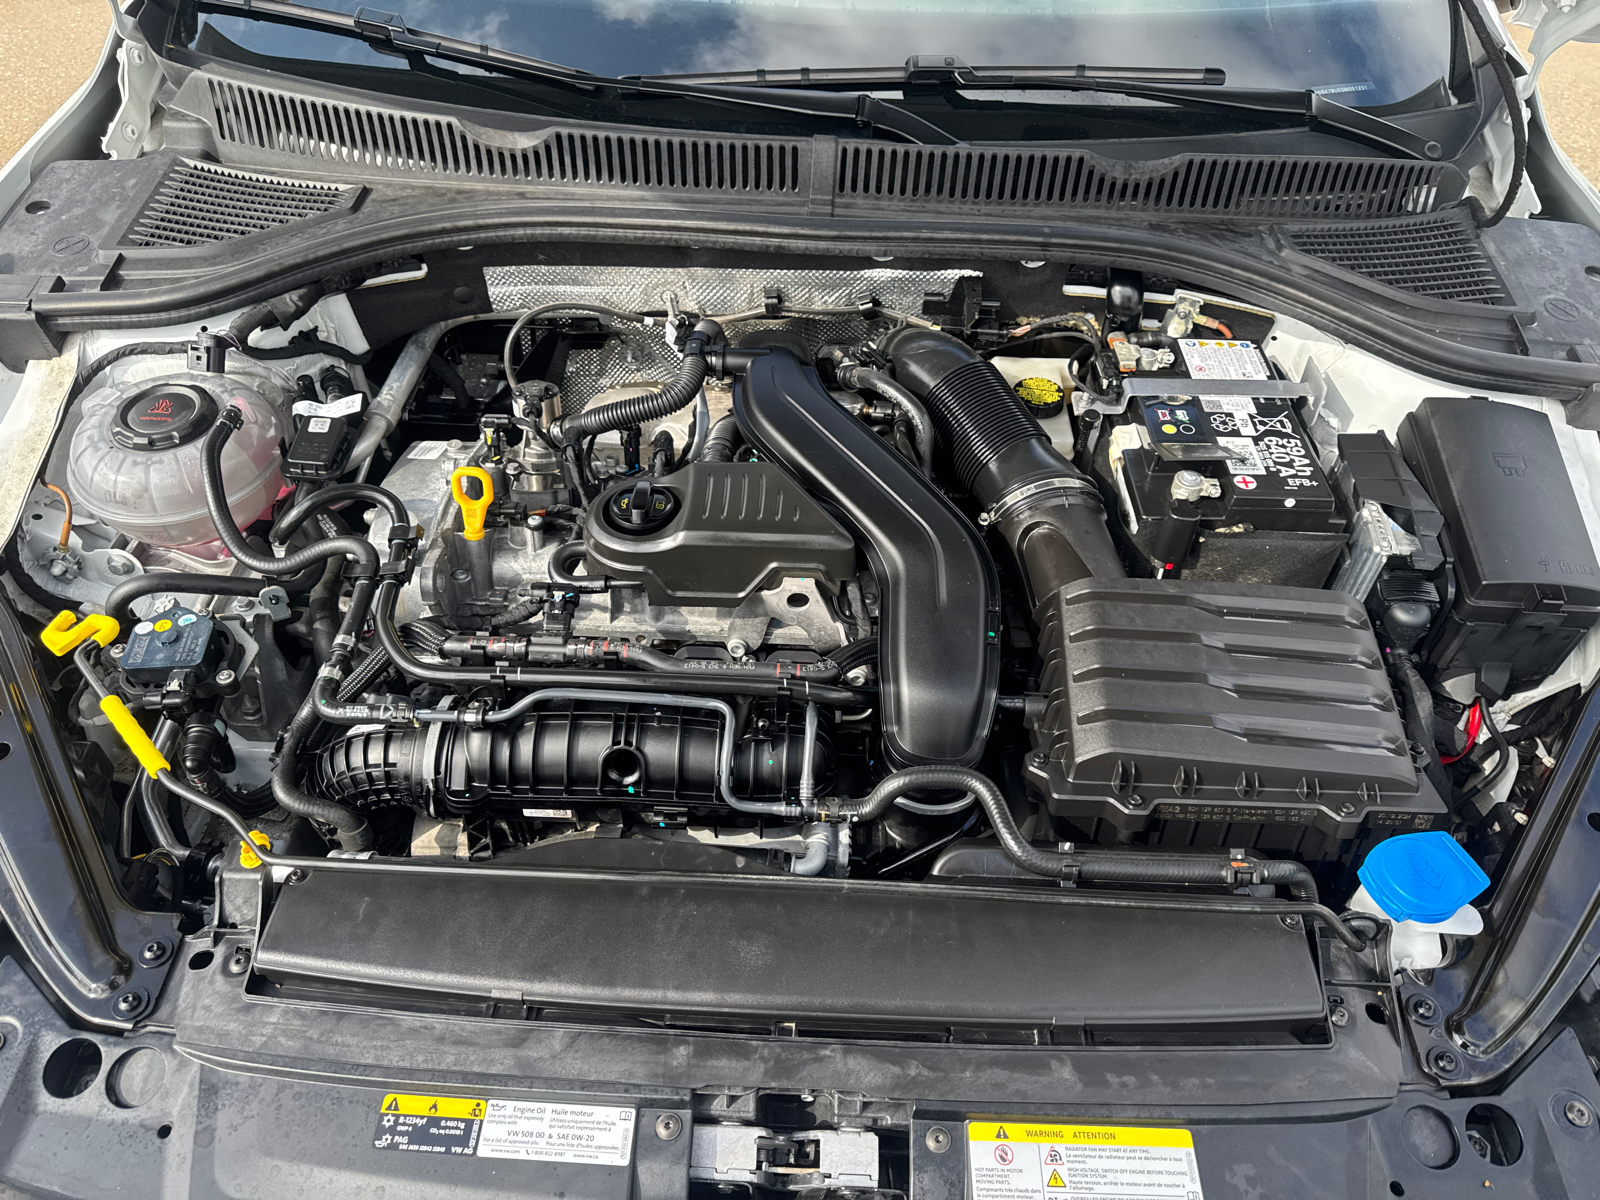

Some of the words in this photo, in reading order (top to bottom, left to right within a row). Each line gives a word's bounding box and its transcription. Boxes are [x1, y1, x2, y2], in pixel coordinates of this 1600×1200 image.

[1238, 418, 1249, 428] Pb
[1264, 437, 1290, 462] 640
[1283, 438, 1313, 476] 59Ah
[1276, 465, 1297, 477] A
[1287, 478, 1318, 487] EFB+
[513, 1106, 535, 1115] Engine
[551, 1108, 569, 1116] Huile
[398, 1116, 427, 1126] R-1234yf
[457, 1121, 465, 1129] kg
[571, 1134, 595, 1142] 0W-20
[1025, 1130, 1064, 1138] WARNING
[1072, 1131, 1116, 1140] ATTENTION
[463, 1147, 473, 1155] AG
